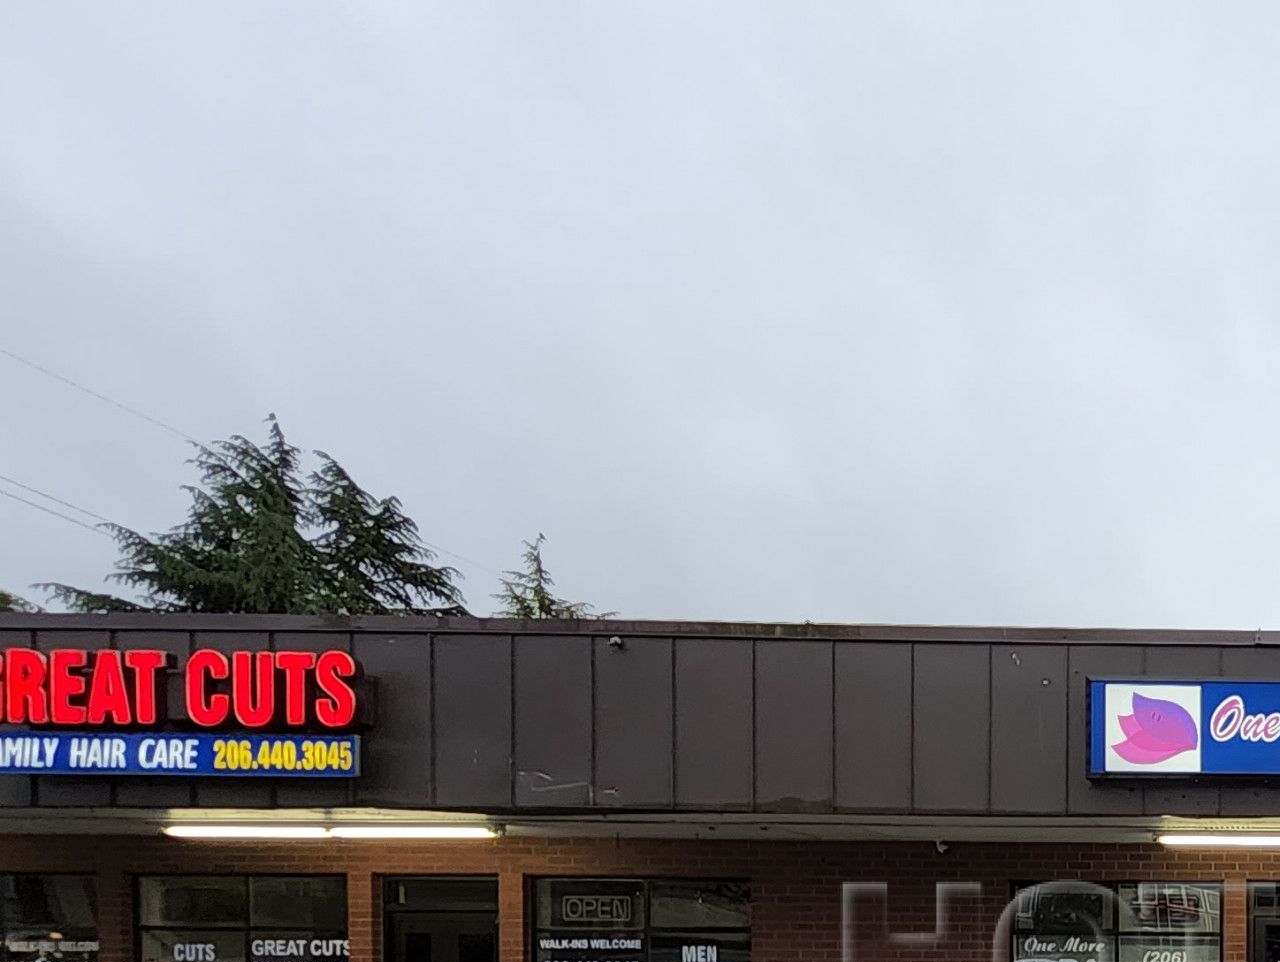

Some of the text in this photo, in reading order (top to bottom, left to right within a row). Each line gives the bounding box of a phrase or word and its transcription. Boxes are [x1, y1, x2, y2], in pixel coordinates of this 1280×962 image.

[0, 648, 356, 727] REAT CUTS
[70, 738, 126, 768] HAIR
[138, 739, 198, 769] CARE
[213, 740, 353, 771] 206.440.3045
[566, 898, 630, 917] OPEN
[173, 943, 216, 961] CUTS
[251, 939, 351, 957] GREAT CUTS
[540, 939, 642, 950] WALK-INS WELCOME
[682, 945, 717, 962] MEN
[1024, 936, 1106, 953] One More
